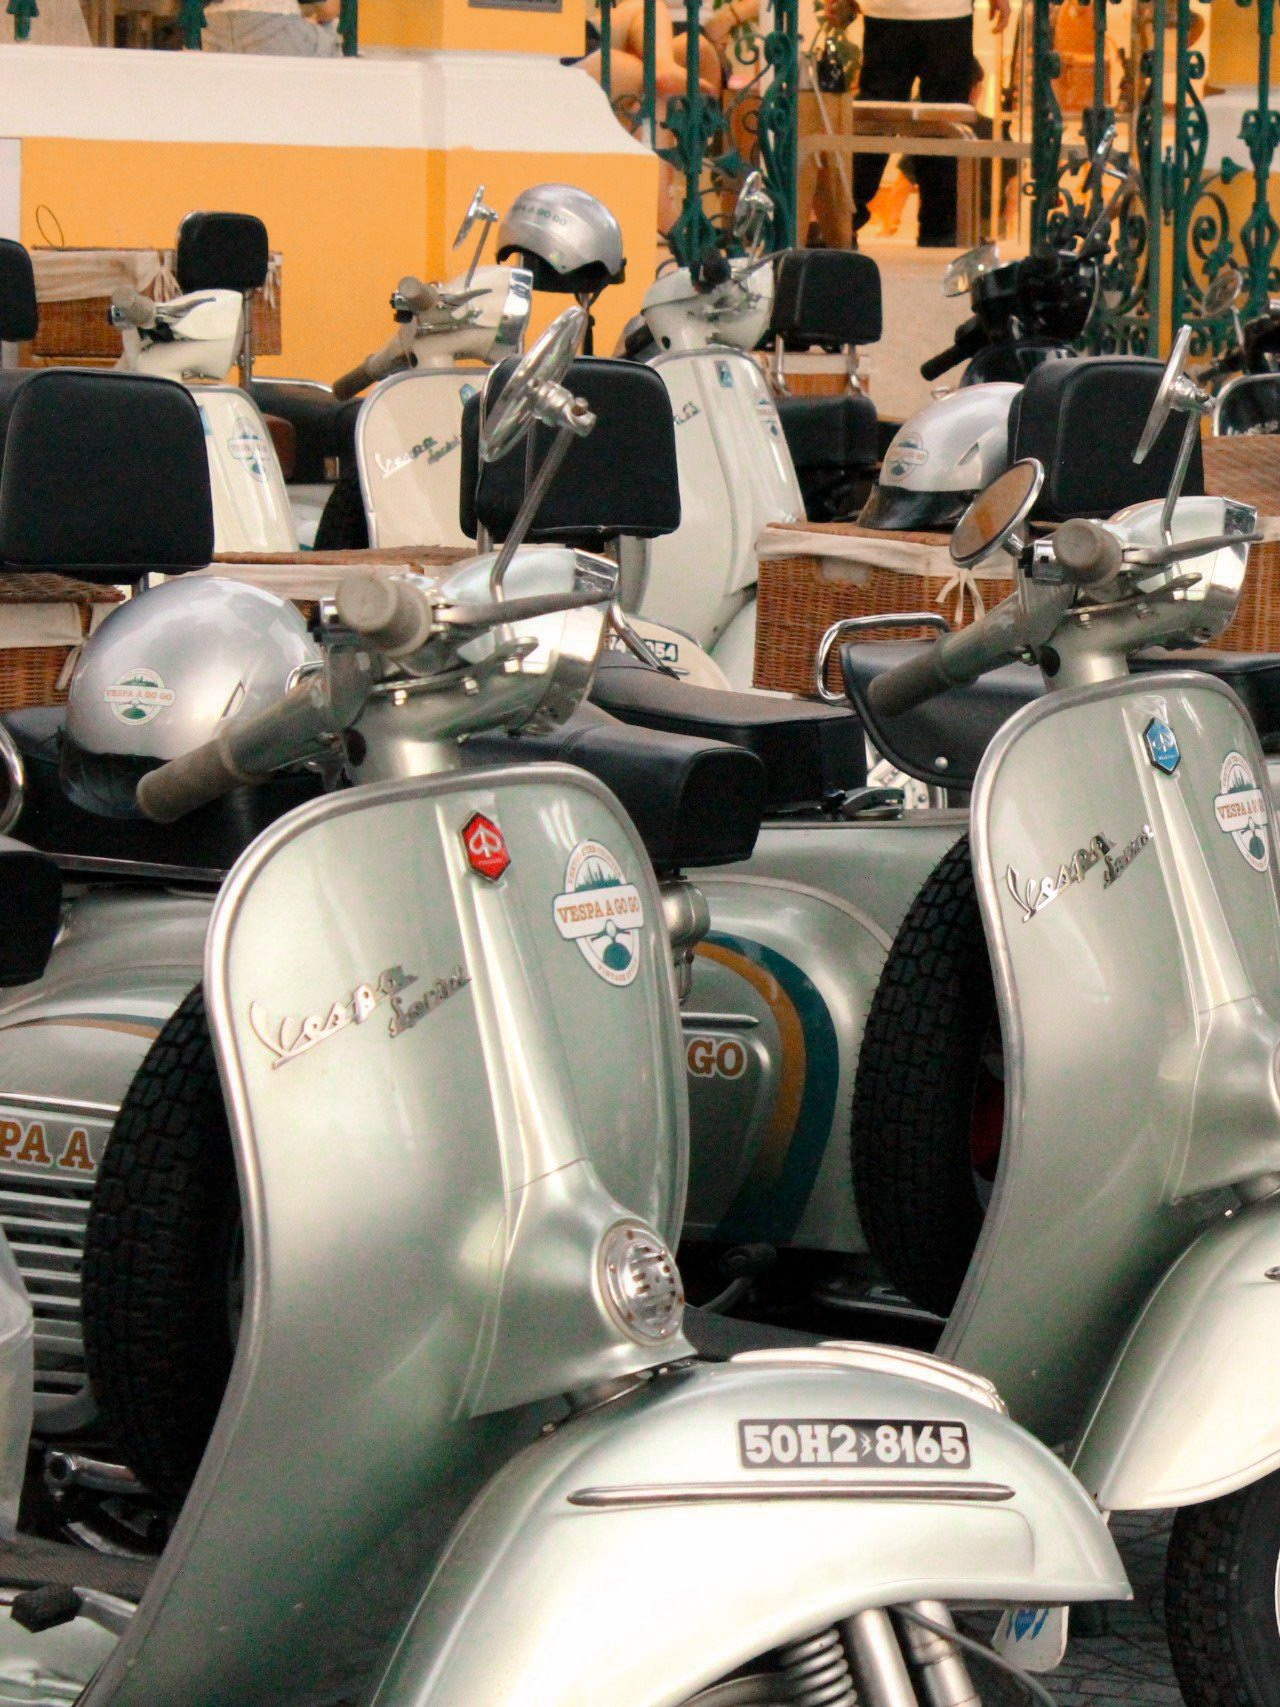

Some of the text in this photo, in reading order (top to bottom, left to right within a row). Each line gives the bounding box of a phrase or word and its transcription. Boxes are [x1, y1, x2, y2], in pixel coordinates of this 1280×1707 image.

[557, 900, 605, 924] VESPA
[605, 899, 614, 916] A
[250, 965, 418, 1071] Vespa
[687, 1039, 746, 1078] GO
[58, 1129, 96, 1171] A
